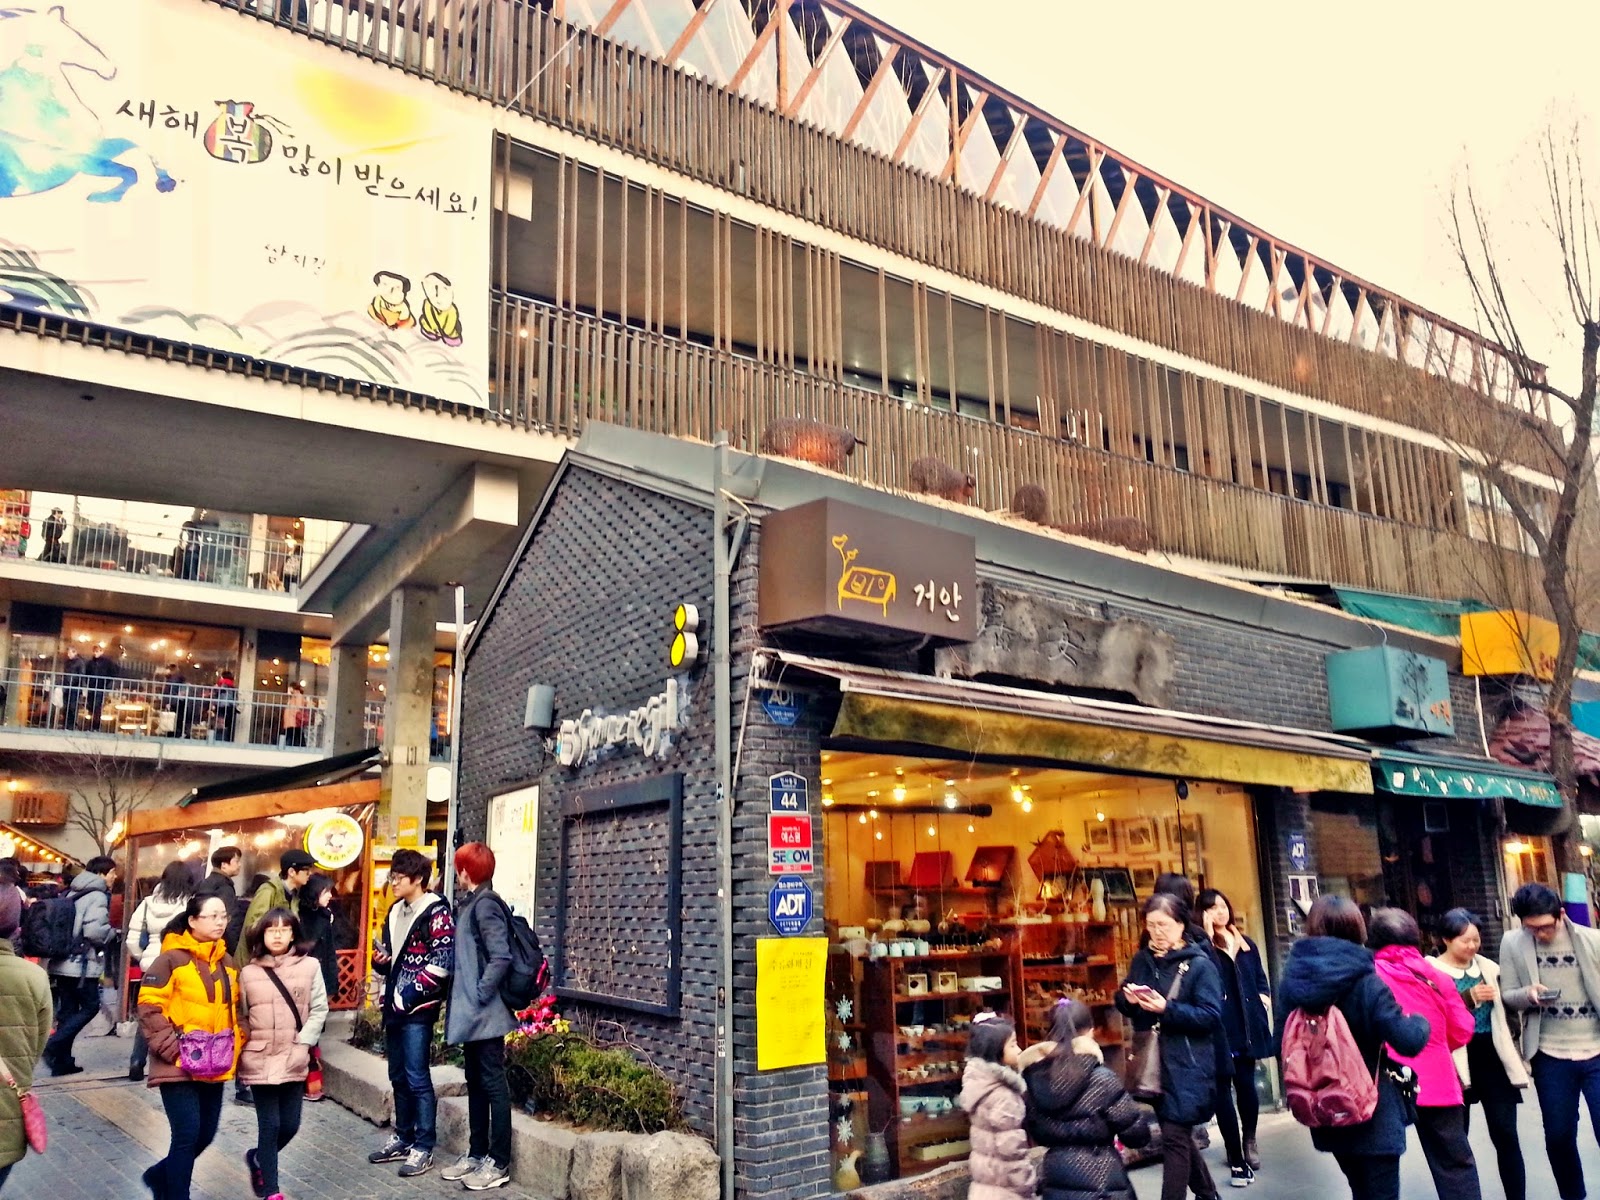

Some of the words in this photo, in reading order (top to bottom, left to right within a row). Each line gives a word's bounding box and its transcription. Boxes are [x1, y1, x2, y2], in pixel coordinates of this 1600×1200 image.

[116, 99, 199, 139] 새해
[282, 144, 342, 186] 많이
[354, 164, 478, 221] 받으세요!
[913, 579, 963, 622] 거안
[780, 792, 799, 809] 44
[773, 850, 810, 863] SECOM
[775, 893, 806, 917] ADT
